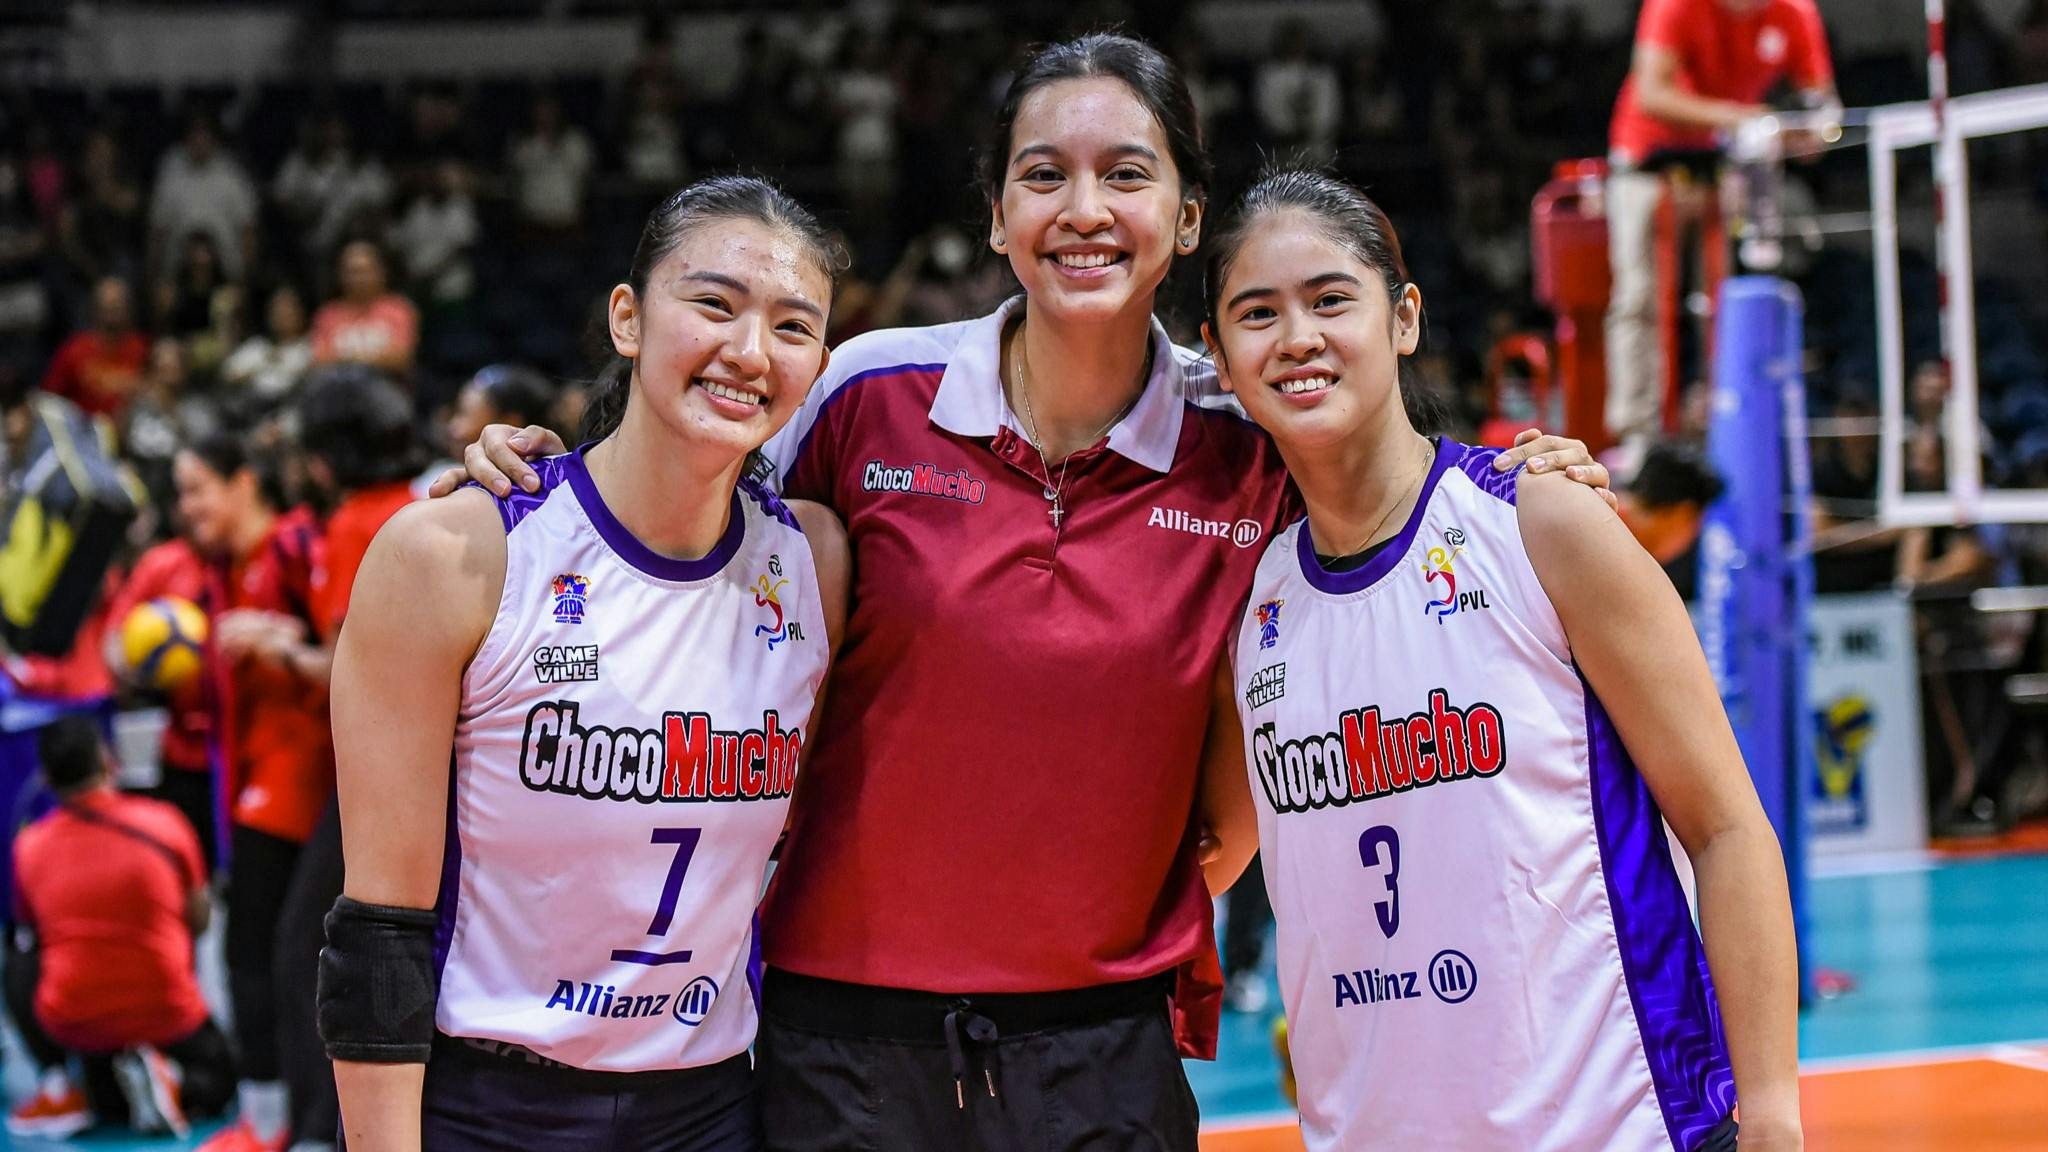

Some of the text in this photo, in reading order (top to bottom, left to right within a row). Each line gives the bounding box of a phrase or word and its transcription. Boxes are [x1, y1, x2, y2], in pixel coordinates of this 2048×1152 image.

[862, 459, 986, 505] ChocoMucho
[1147, 506, 1231, 539] Allianz
[552, 599, 586, 617] BIDA
[1459, 589, 1490, 612] PVL
[534, 644, 599, 664] GAME
[534, 662, 599, 684] VILLE
[519, 699, 802, 804] ChocoMucho
[646, 827, 702, 937] 7
[1358, 824, 1400, 939] 3
[545, 978, 671, 1019] Allianz
